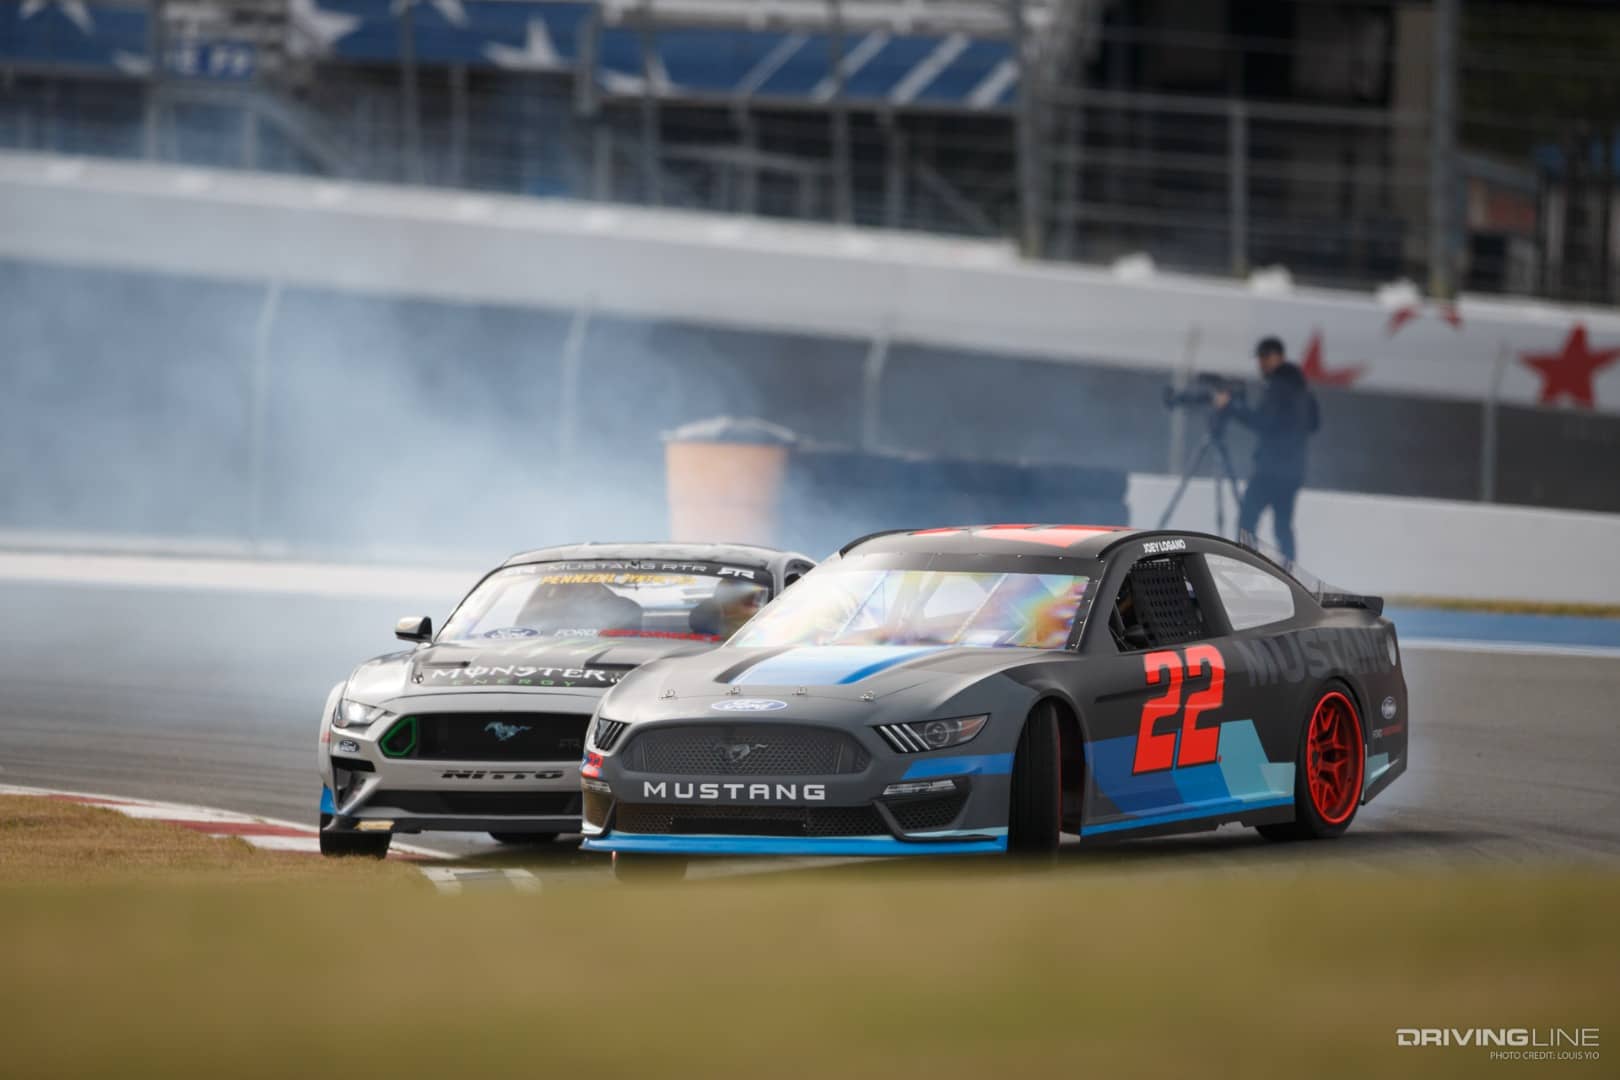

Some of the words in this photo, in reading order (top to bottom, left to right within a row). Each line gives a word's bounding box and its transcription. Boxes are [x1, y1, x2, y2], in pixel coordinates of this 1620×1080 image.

[1142, 542, 1159, 553] JOEY
[1159, 539, 1186, 552] LOGANO
[550, 561, 656, 573] MUSTANG
[662, 563, 706, 573] RTR
[540, 573, 616, 585] PENNZOIL
[431, 664, 607, 682] MONSTER
[452, 677, 577, 687] ENERGY
[1132, 643, 1226, 776] 22
[441, 769, 565, 780] NITTO
[643, 781, 826, 800] MUSTANG
